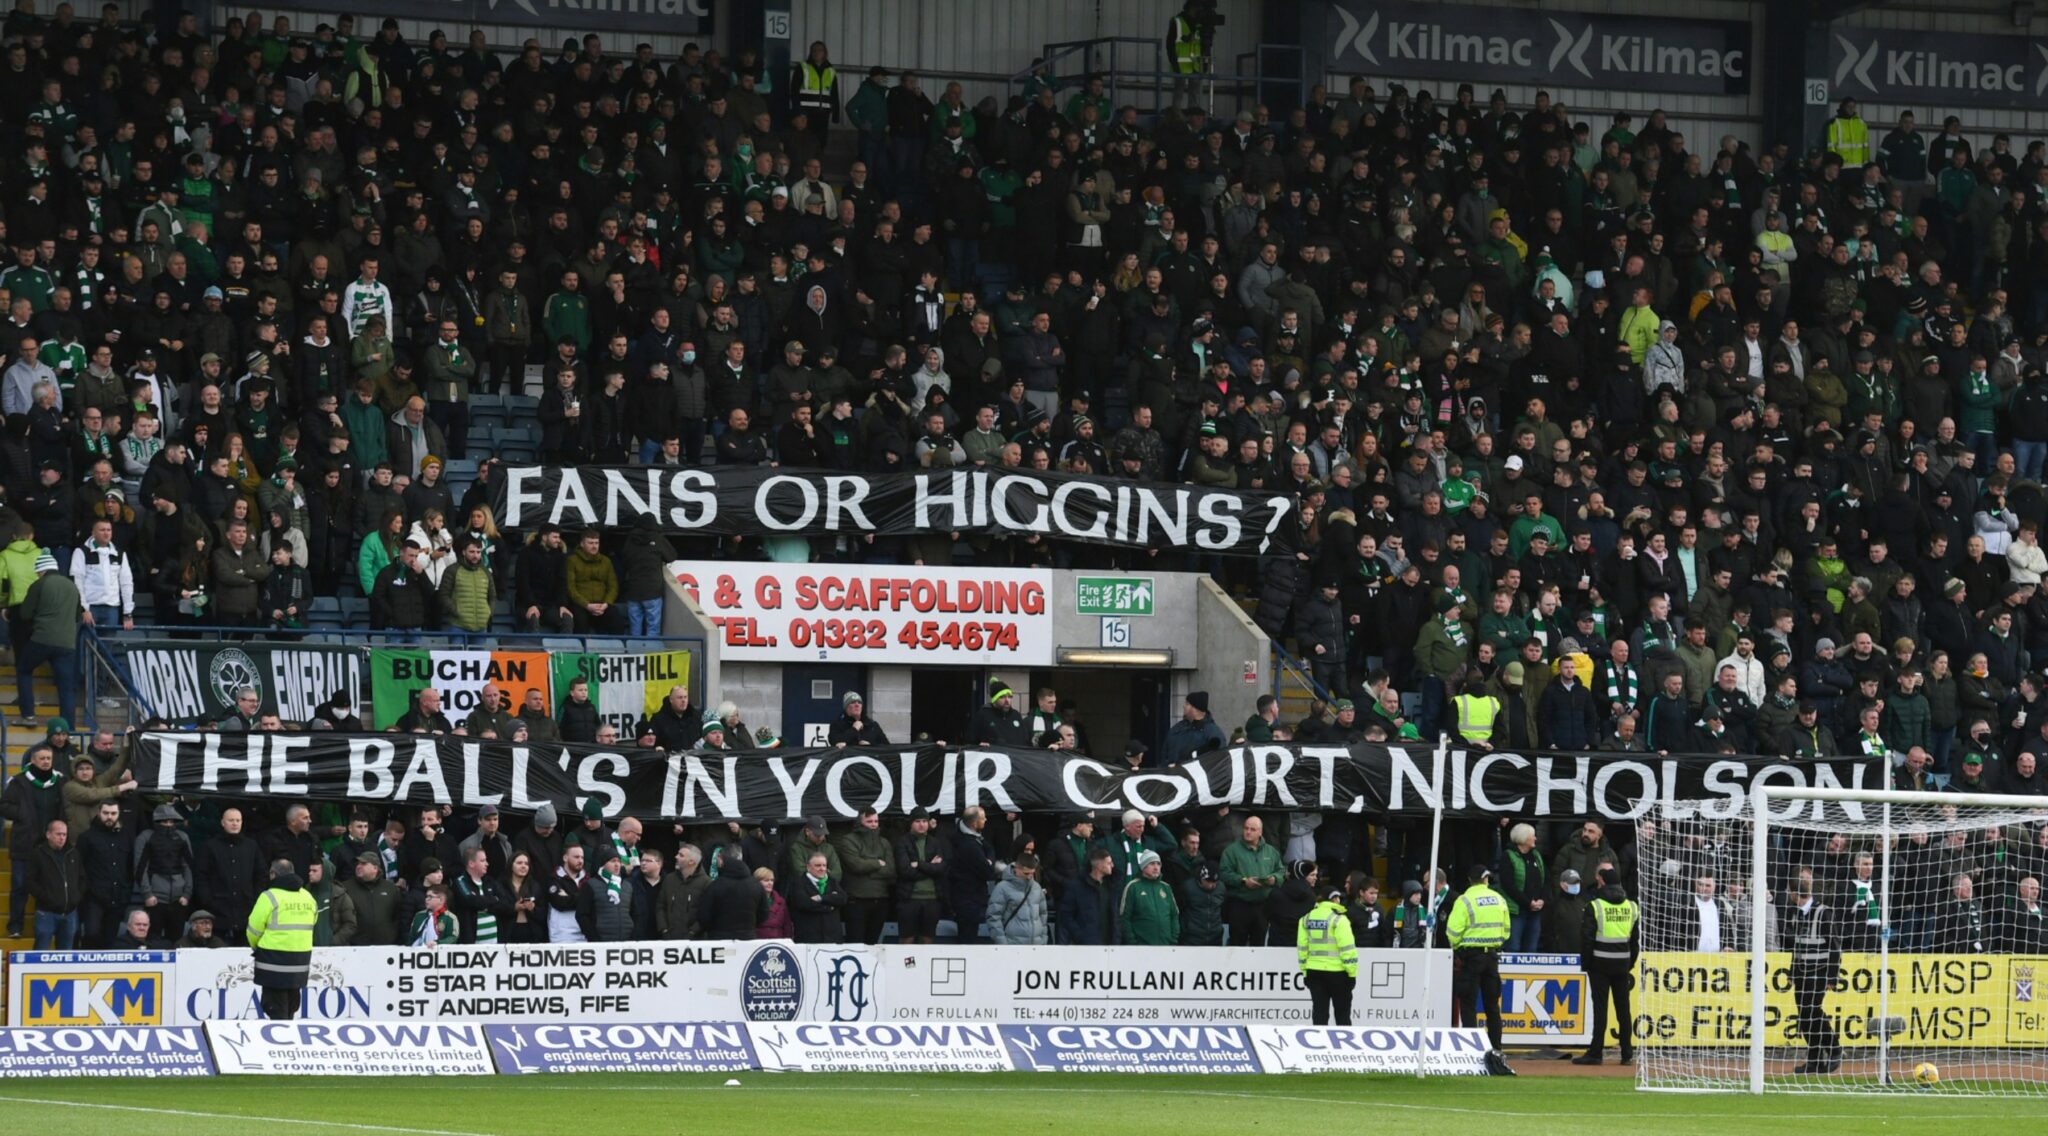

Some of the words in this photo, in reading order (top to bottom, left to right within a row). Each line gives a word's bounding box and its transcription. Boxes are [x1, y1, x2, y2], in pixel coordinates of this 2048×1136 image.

[769, 16, 787, 35] 15
[1388, 22, 1532, 66] Kilmac
[1602, 34, 1743, 78] Kilmac
[1886, 50, 2025, 92] Kilmac
[1808, 83, 1825, 101] 16
[504, 465, 719, 528] FANS
[754, 475, 877, 530] OR
[714, 574, 742, 609] &
[754, 575, 781, 610] G
[795, 576, 1045, 615] SCAFFOLDING
[1080, 584, 1099, 595] Fire
[1080, 596, 1100, 607] Exit
[789, 618, 886, 649] 01382
[898, 621, 1019, 651] 454674
[1105, 622, 1126, 642] 15
[393, 658, 527, 682] BUCHAN
[577, 654, 678, 684] SIGHTHILL
[127, 649, 206, 722] MORAY
[140, 732, 311, 794] THE
[660, 754, 743, 818] IN
[766, 750, 1023, 818] YOUR
[1386, 746, 1866, 821] NICHOLSON
[1307, 920, 1328, 929] POLICE
[41, 953, 73, 962] GATE
[78, 953, 133, 962] NUMBER
[136, 953, 149, 961] 14
[399, 950, 498, 970] HOLIDAY
[509, 949, 596, 969] HOMES
[606, 948, 654, 967] FOR
[664, 946, 726, 965] SALE
[1517, 956, 1562, 964] NUMBER
[398, 976, 413, 993] 5
[424, 975, 486, 992] STAR
[496, 972, 595, 991] HOLIDAY
[605, 971, 668, 989] PARK
[748, 975, 796, 989] Scottish
[1013, 970, 1060, 994] JON
[1069, 970, 1185, 991] FRULLANI
[1192, 971, 1306, 991] ARCHITEC
[1640, 959, 1730, 993] hona
[1911, 960, 1992, 994] MSP
[29, 978, 155, 1024] MKM
[186, 985, 375, 1021] CLATON
[398, 999, 429, 1017] ST
[438, 996, 569, 1017] ANDREWS,
[581, 995, 630, 1013] FIFE
[754, 1012, 788, 1020] HOLIDAY
[892, 1007, 920, 1019] JON
[927, 1007, 998, 1019] FRULLANI
[1013, 1007, 1035, 1020] TEL:
[1038, 1007, 1060, 1020] +44
[1112, 1008, 1133, 1019] 224
[1138, 1008, 1159, 1019] 828
[1170, 1008, 1311, 1021] WWW.JFARCHITECT.CO.U
[1910, 1006, 1991, 1040] MSP
[2015, 1011, 2045, 1030] Tel:
[260, 1023, 478, 1047] CROWN
[1530, 1020, 1575, 1029] SUPPLIES
[534, 1025, 742, 1049] CROWN
[796, 1025, 995, 1047] CROWN
[1047, 1026, 1244, 1049] CROWN
[1295, 1028, 1485, 1051] CROWN
[0, 1052, 77, 1068] gineering
[81, 1052, 143, 1065] services
[147, 1051, 205, 1064] limited
[268, 1048, 359, 1061] engineering
[363, 1049, 424, 1060] services
[428, 1049, 483, 1060] limited
[543, 1049, 631, 1063] engineering
[634, 1048, 692, 1061] services
[695, 1048, 748, 1060] limited
[805, 1047, 889, 1062] engineering
[892, 1047, 948, 1059] services
[950, 1046, 1002, 1059] limited
[1056, 1049, 1139, 1064] engineering
[1143, 1049, 1197, 1062] services
[1199, 1049, 1249, 1062] limited
[1305, 1051, 1385, 1065] engineering
[1443, 1052, 1484, 1065] limite
[0, 1064, 209, 1078] rown-engineering.co.uk
[273, 1062, 487, 1074] crown-engineering.co.uk
